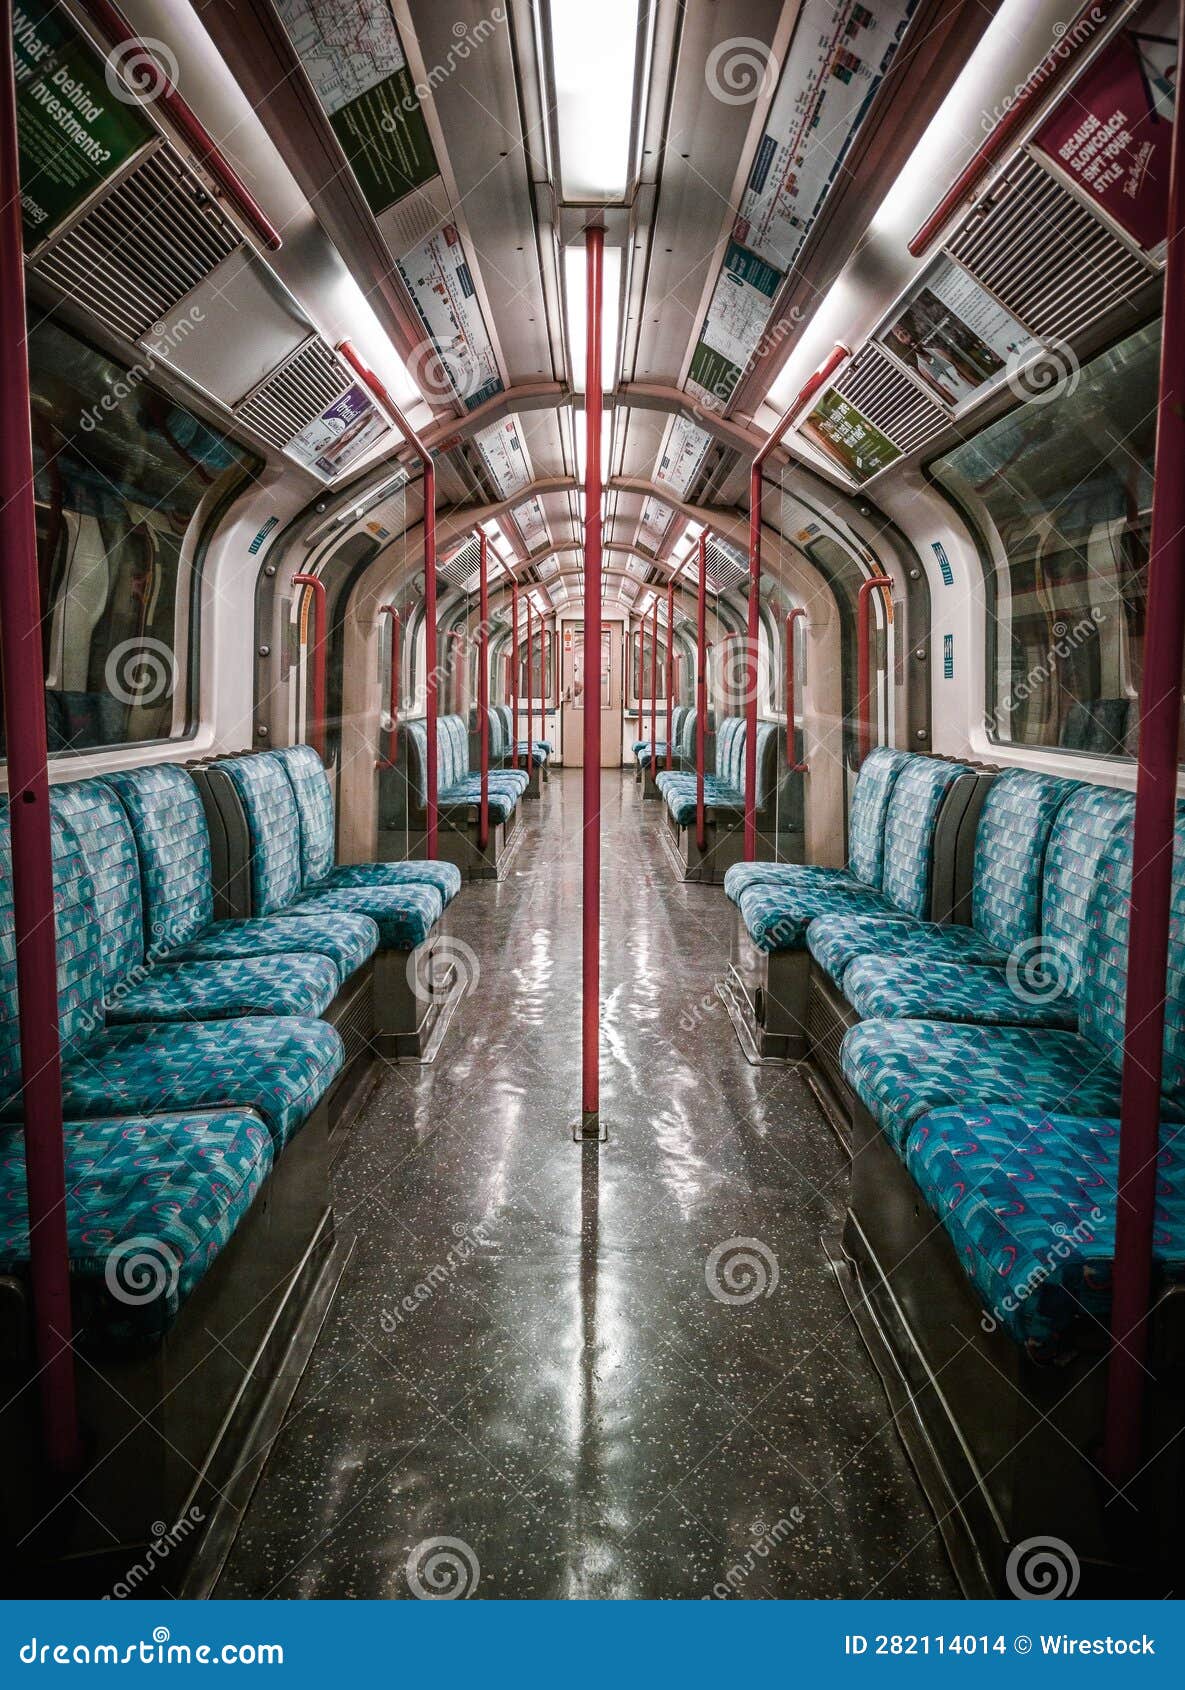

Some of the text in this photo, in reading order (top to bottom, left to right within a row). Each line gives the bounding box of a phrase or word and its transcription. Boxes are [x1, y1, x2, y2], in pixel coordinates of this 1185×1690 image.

[13, 7, 57, 73] What's
[52, 65, 104, 123] behind
[30, 76, 112, 165] investments?
[1058, 113, 1102, 161] BECAUSE
[1070, 110, 1128, 172] SLOWCOACH
[1081, 130, 1134, 183] ISN'T YOUR
[1092, 162, 1125, 193] STYLE
[21, 194, 49, 224] tmeg
